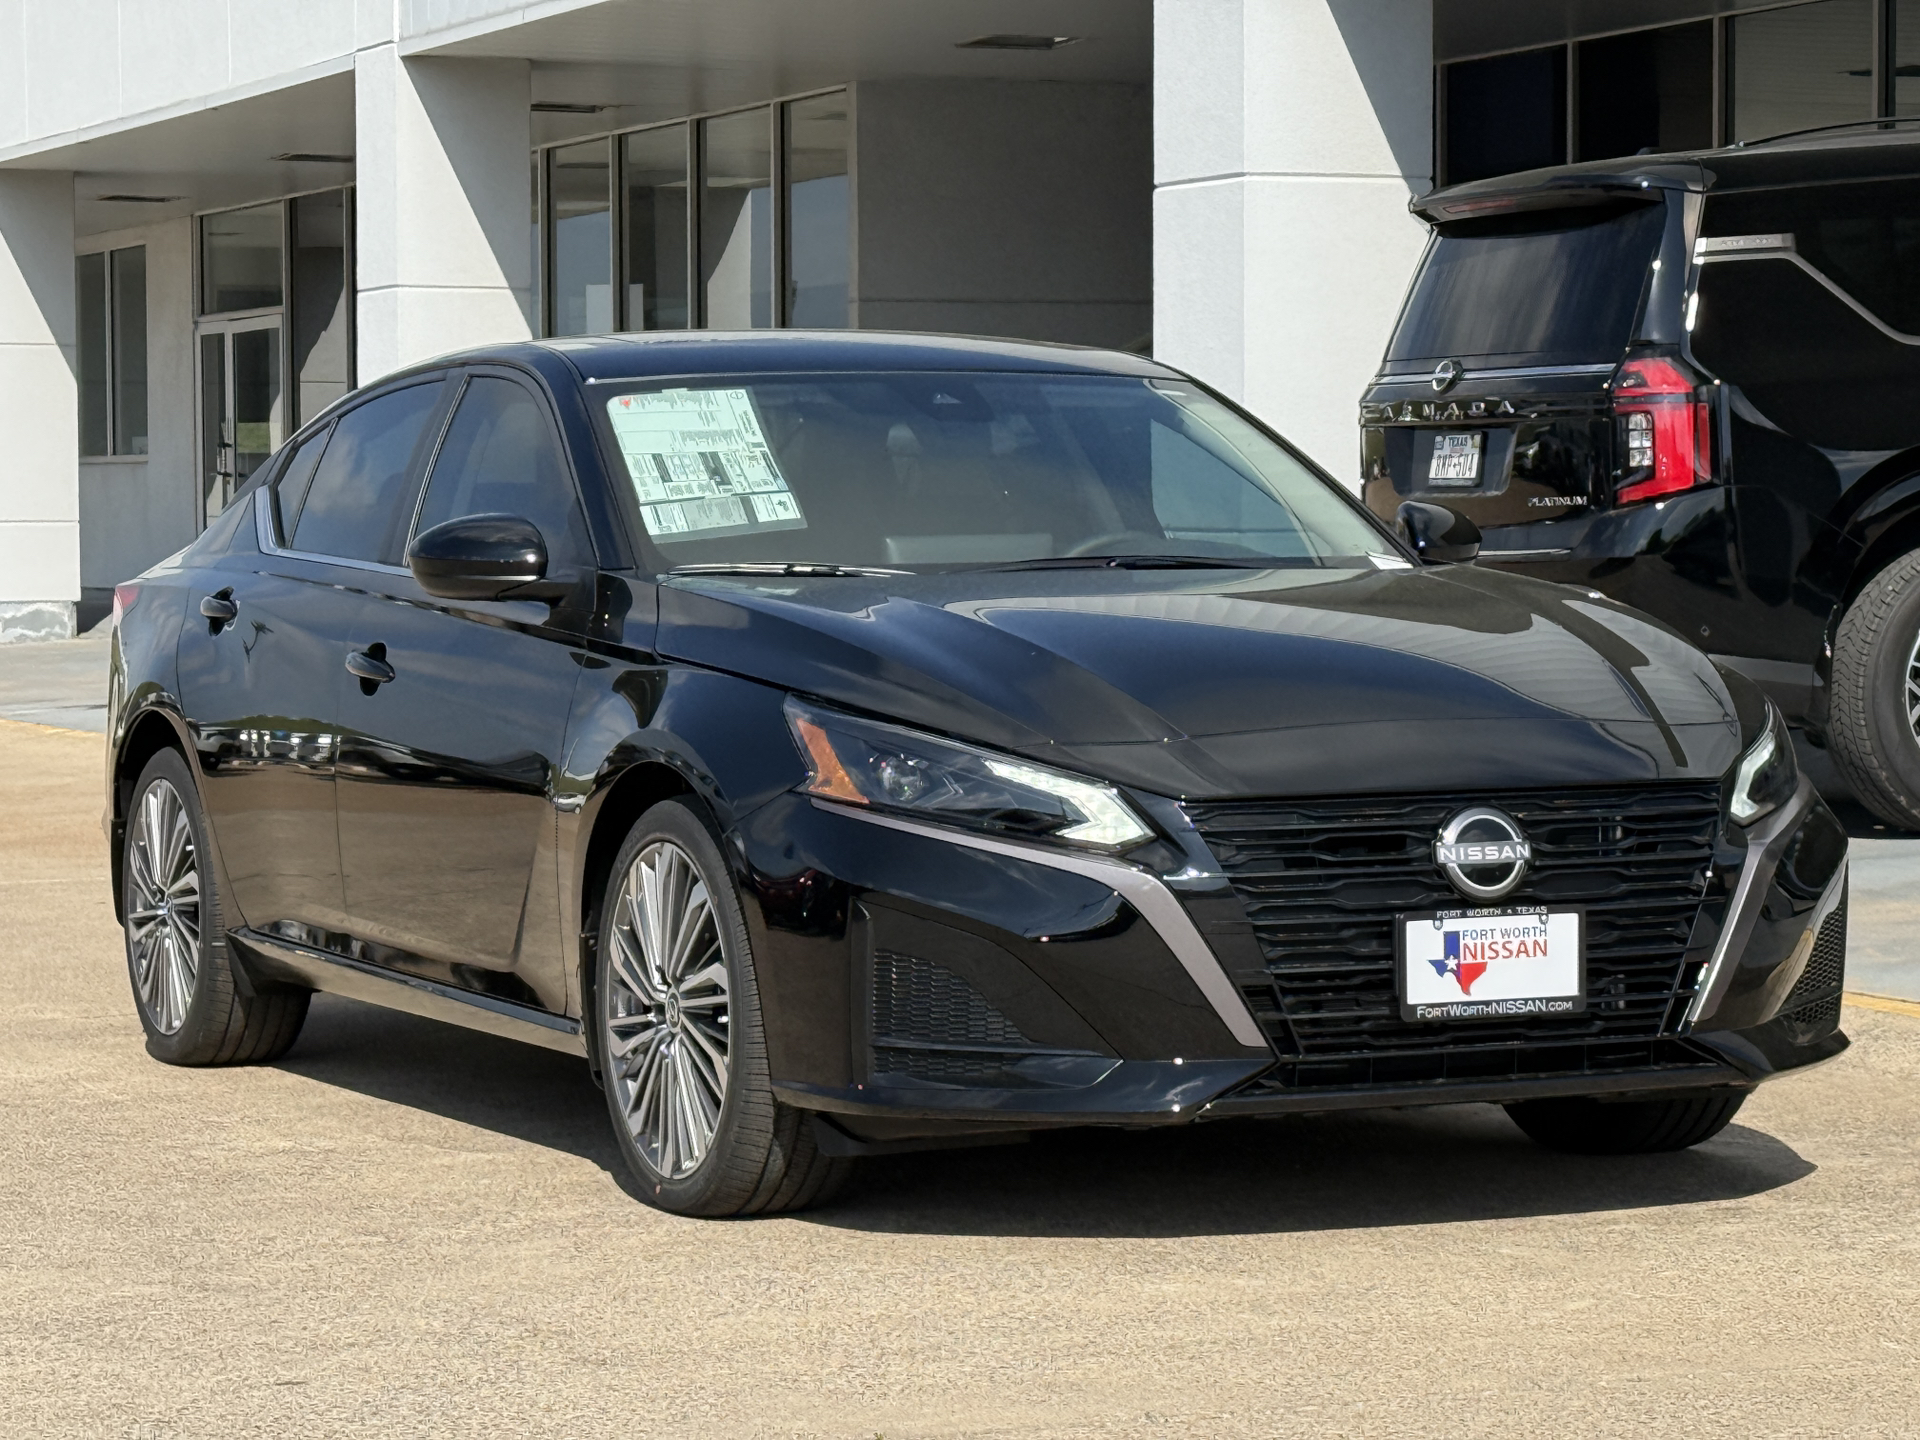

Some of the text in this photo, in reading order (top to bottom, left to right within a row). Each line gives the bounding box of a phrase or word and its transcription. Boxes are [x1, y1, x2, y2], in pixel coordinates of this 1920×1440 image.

[1448, 436, 1469, 447] TEXAS
[1527, 495, 1588, 507] PLATINUM
[1439, 844, 1530, 861] NISSAN
[1436, 905, 1548, 919] FORT WORTH TEXAS
[1462, 926, 1548, 941] FORT WORTH
[1462, 938, 1548, 962] NISSAN
